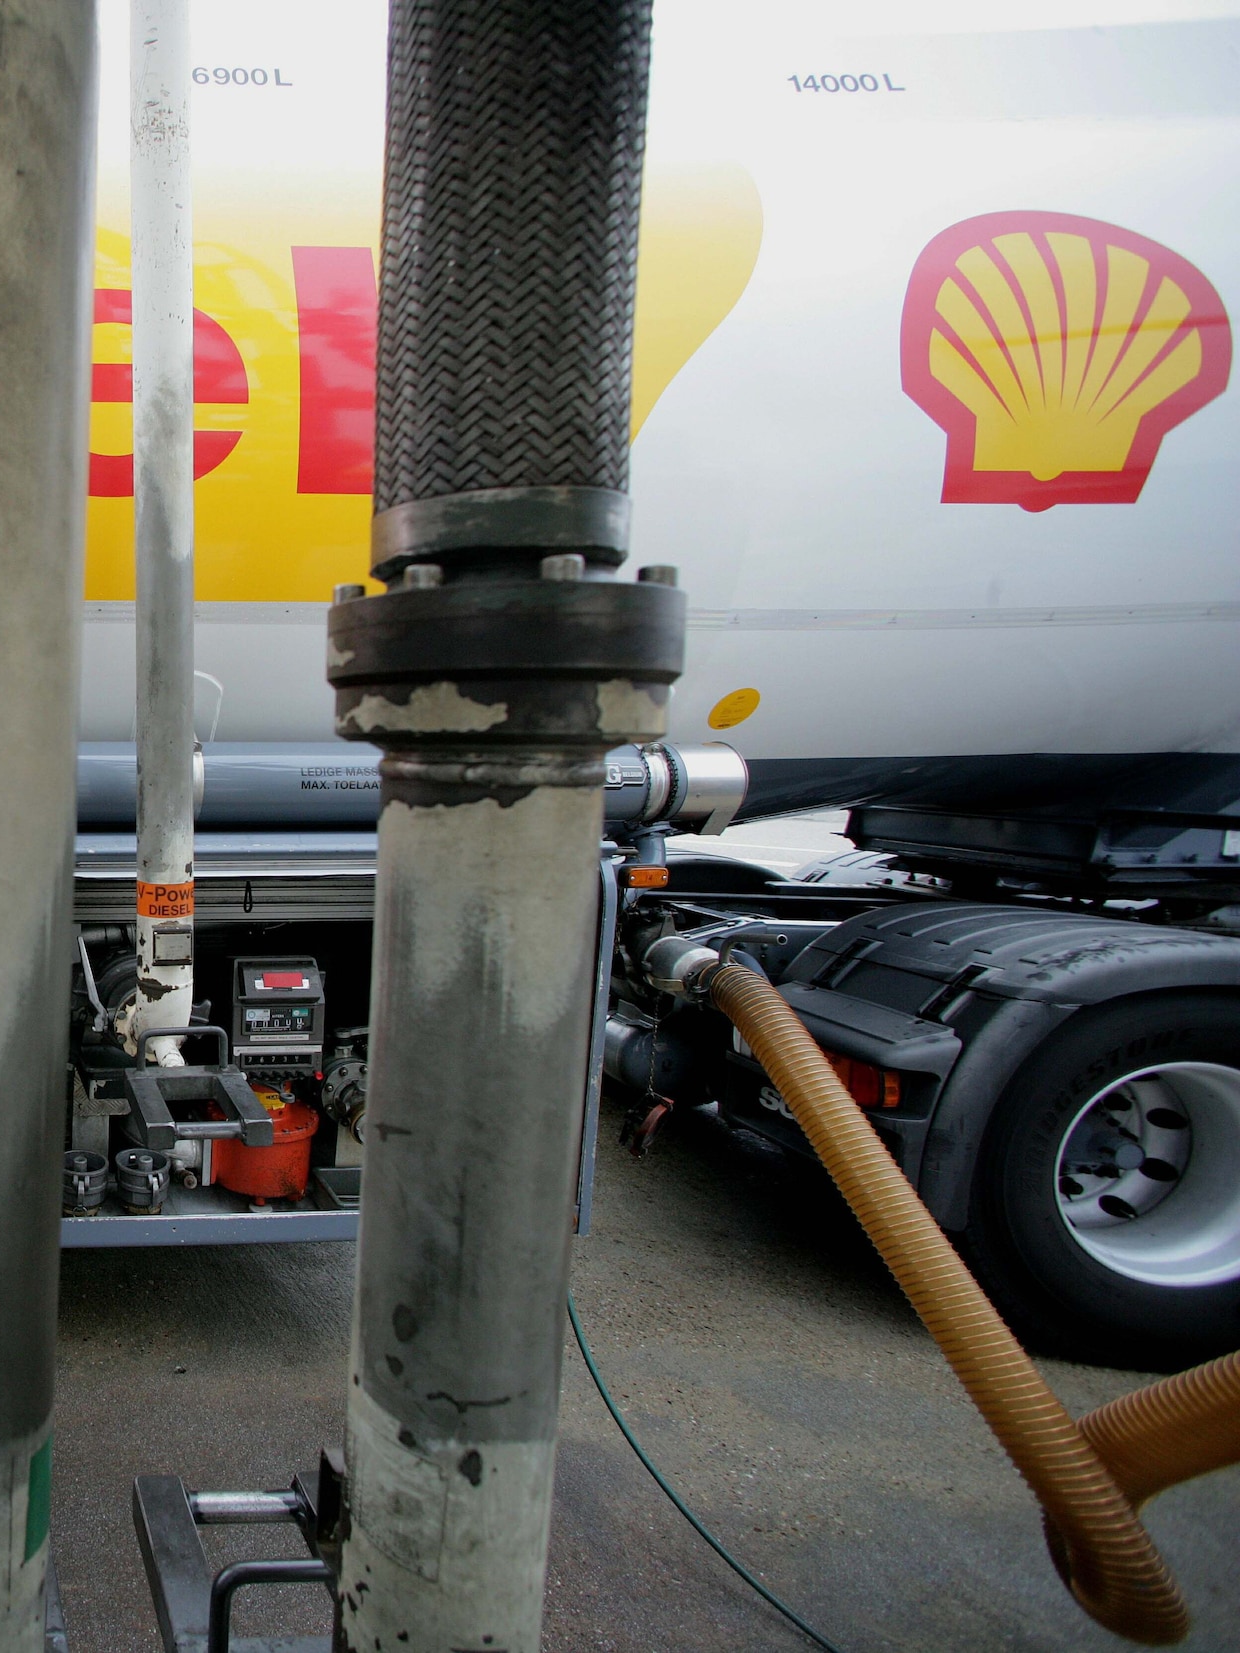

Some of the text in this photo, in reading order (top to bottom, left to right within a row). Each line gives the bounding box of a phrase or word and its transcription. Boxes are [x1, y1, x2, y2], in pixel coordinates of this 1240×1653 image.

[346, 767, 382, 777] MASS
[301, 780, 330, 790] MAX.
[149, 904, 191, 916] DIESEL
